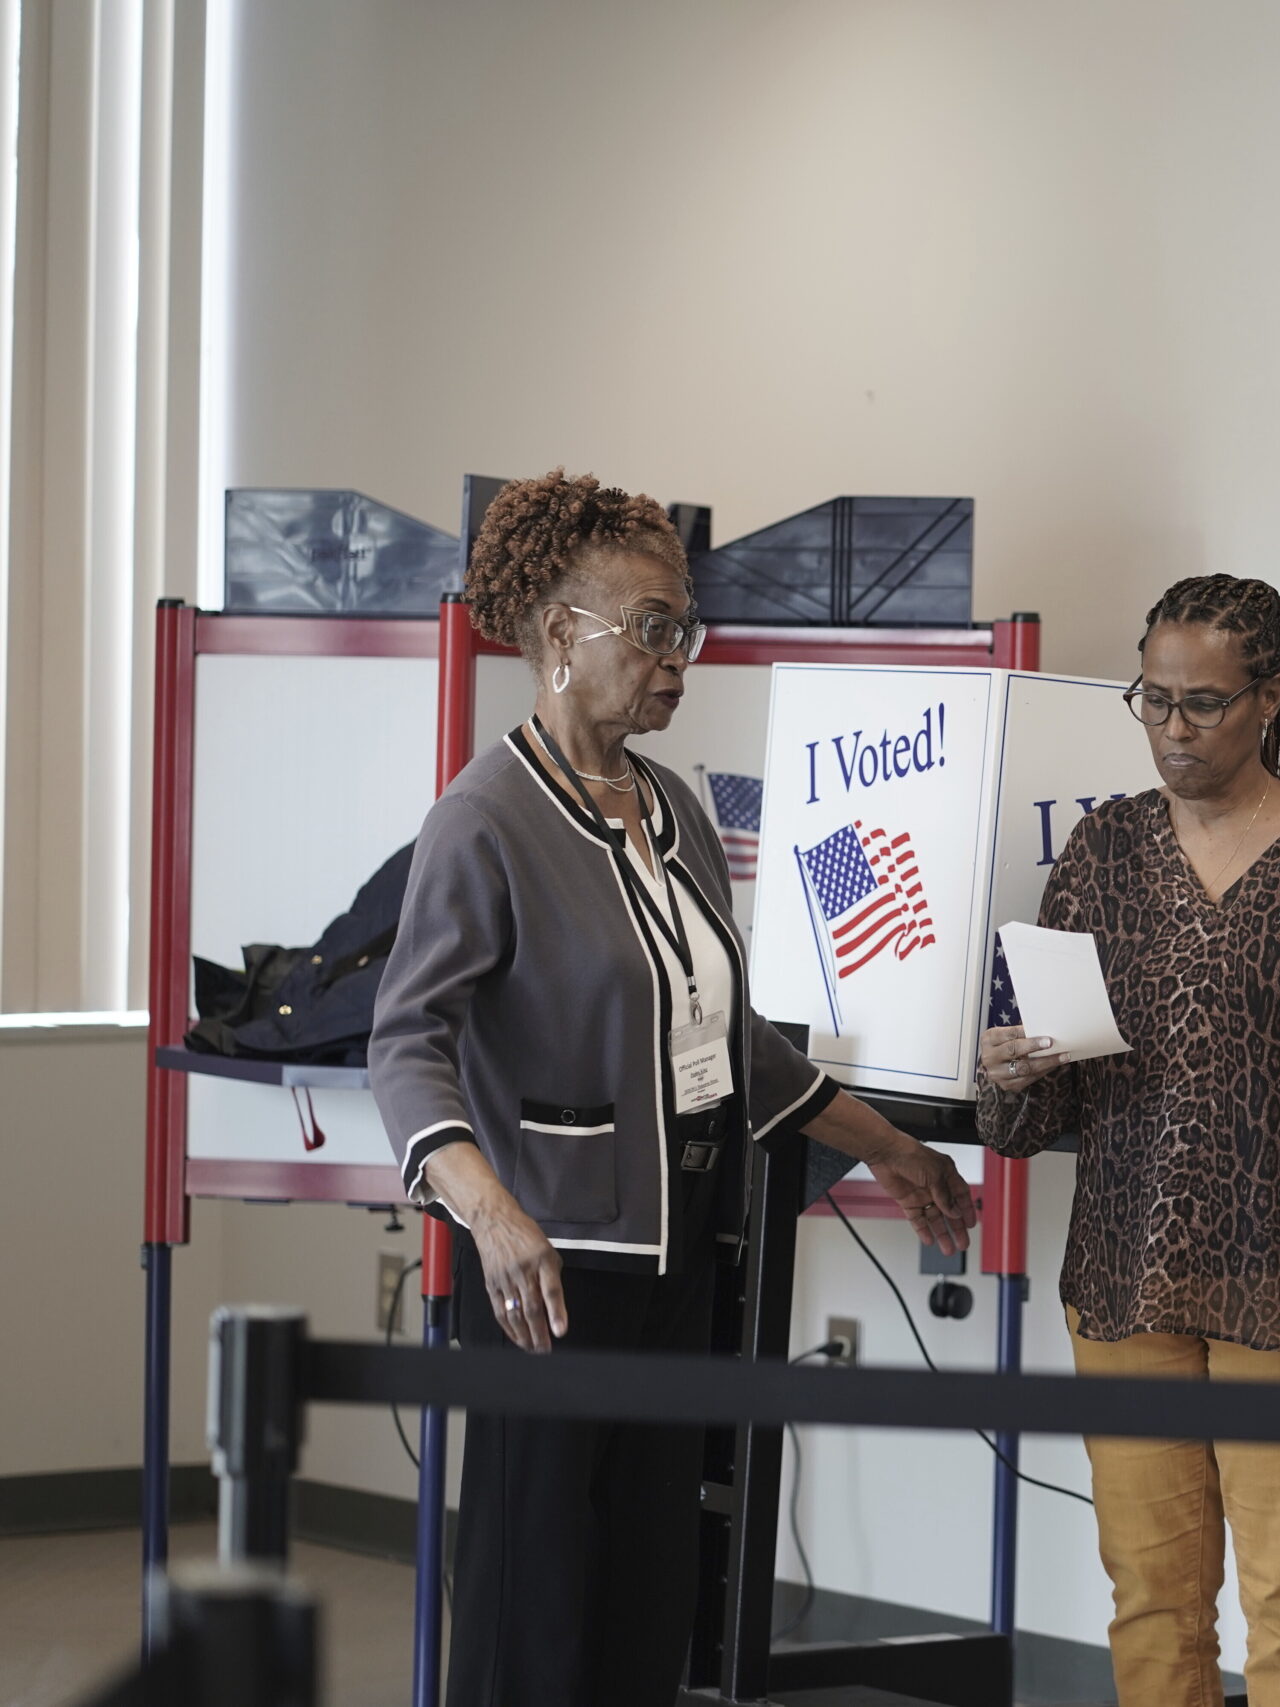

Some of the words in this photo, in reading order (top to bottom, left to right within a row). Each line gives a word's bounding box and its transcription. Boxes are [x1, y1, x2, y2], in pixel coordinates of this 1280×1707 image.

[806, 741, 820, 804] I
[831, 702, 946, 793] Voted!
[1034, 799, 1057, 866] I
